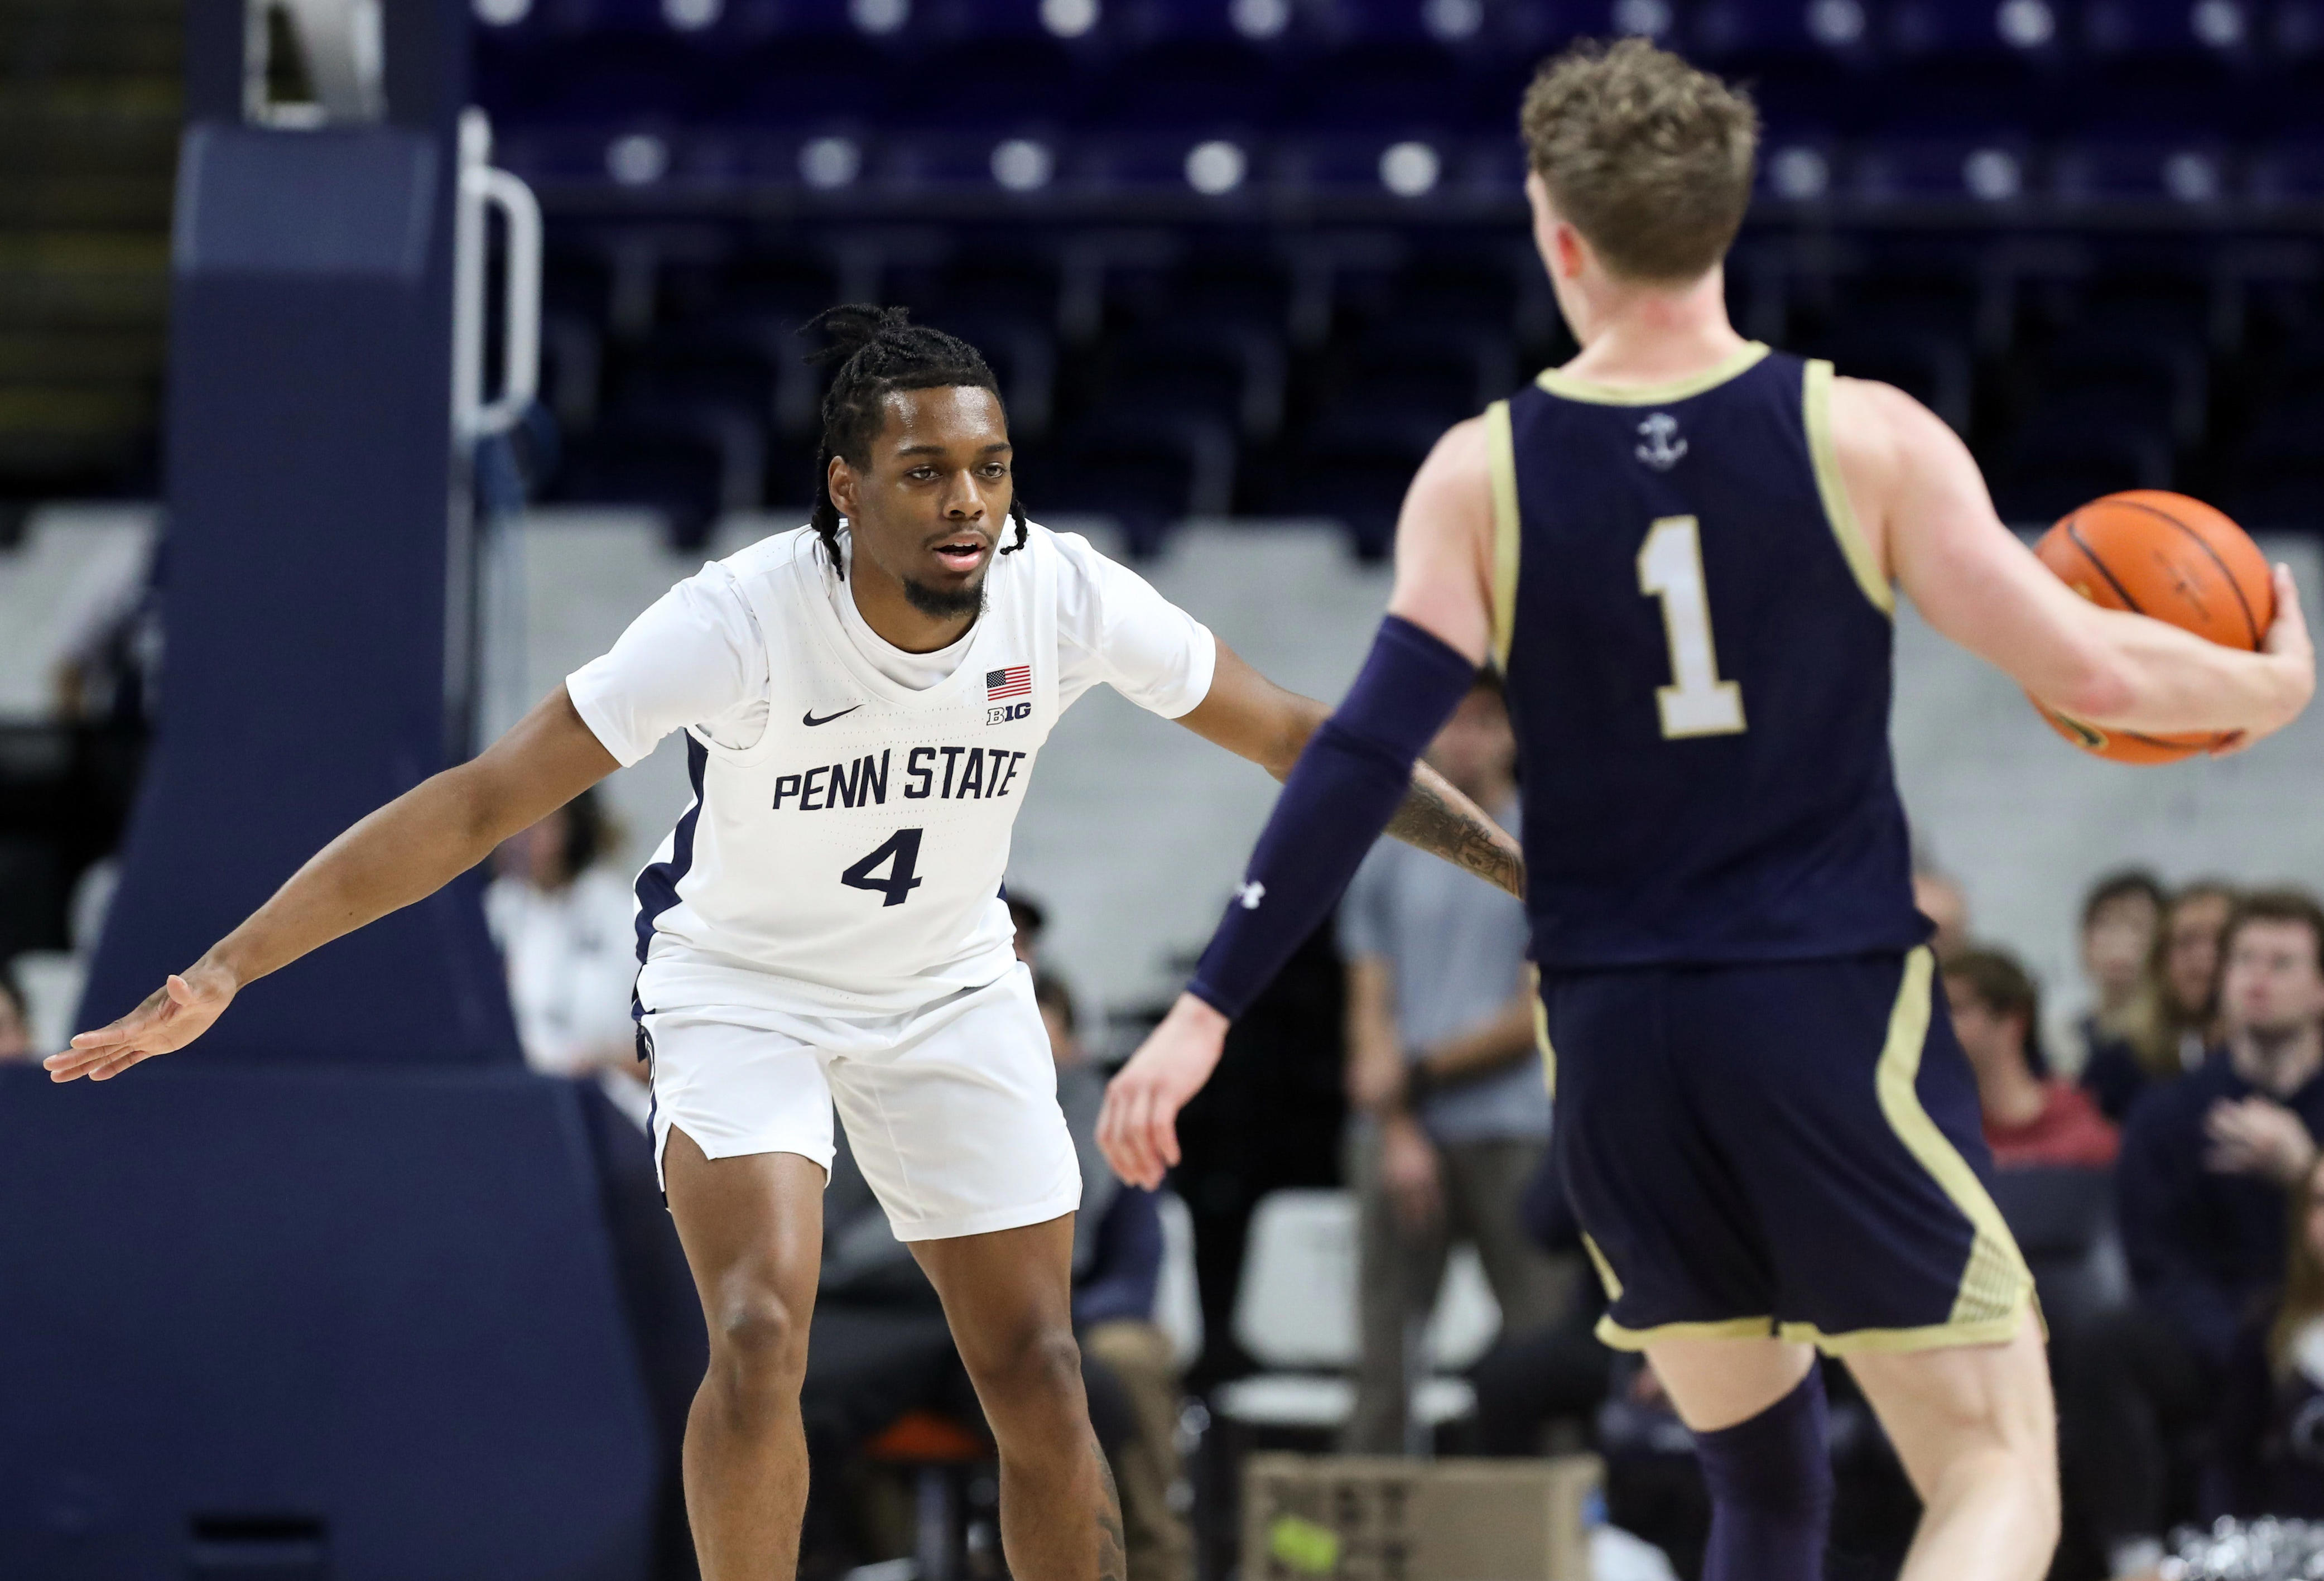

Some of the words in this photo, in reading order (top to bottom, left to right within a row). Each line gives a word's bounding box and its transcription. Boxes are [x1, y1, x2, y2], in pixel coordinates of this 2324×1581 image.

[1636, 514, 1747, 740] 1
[772, 748, 891, 810] PENN
[904, 746, 1026, 799] STATE
[841, 828, 923, 907] 4
